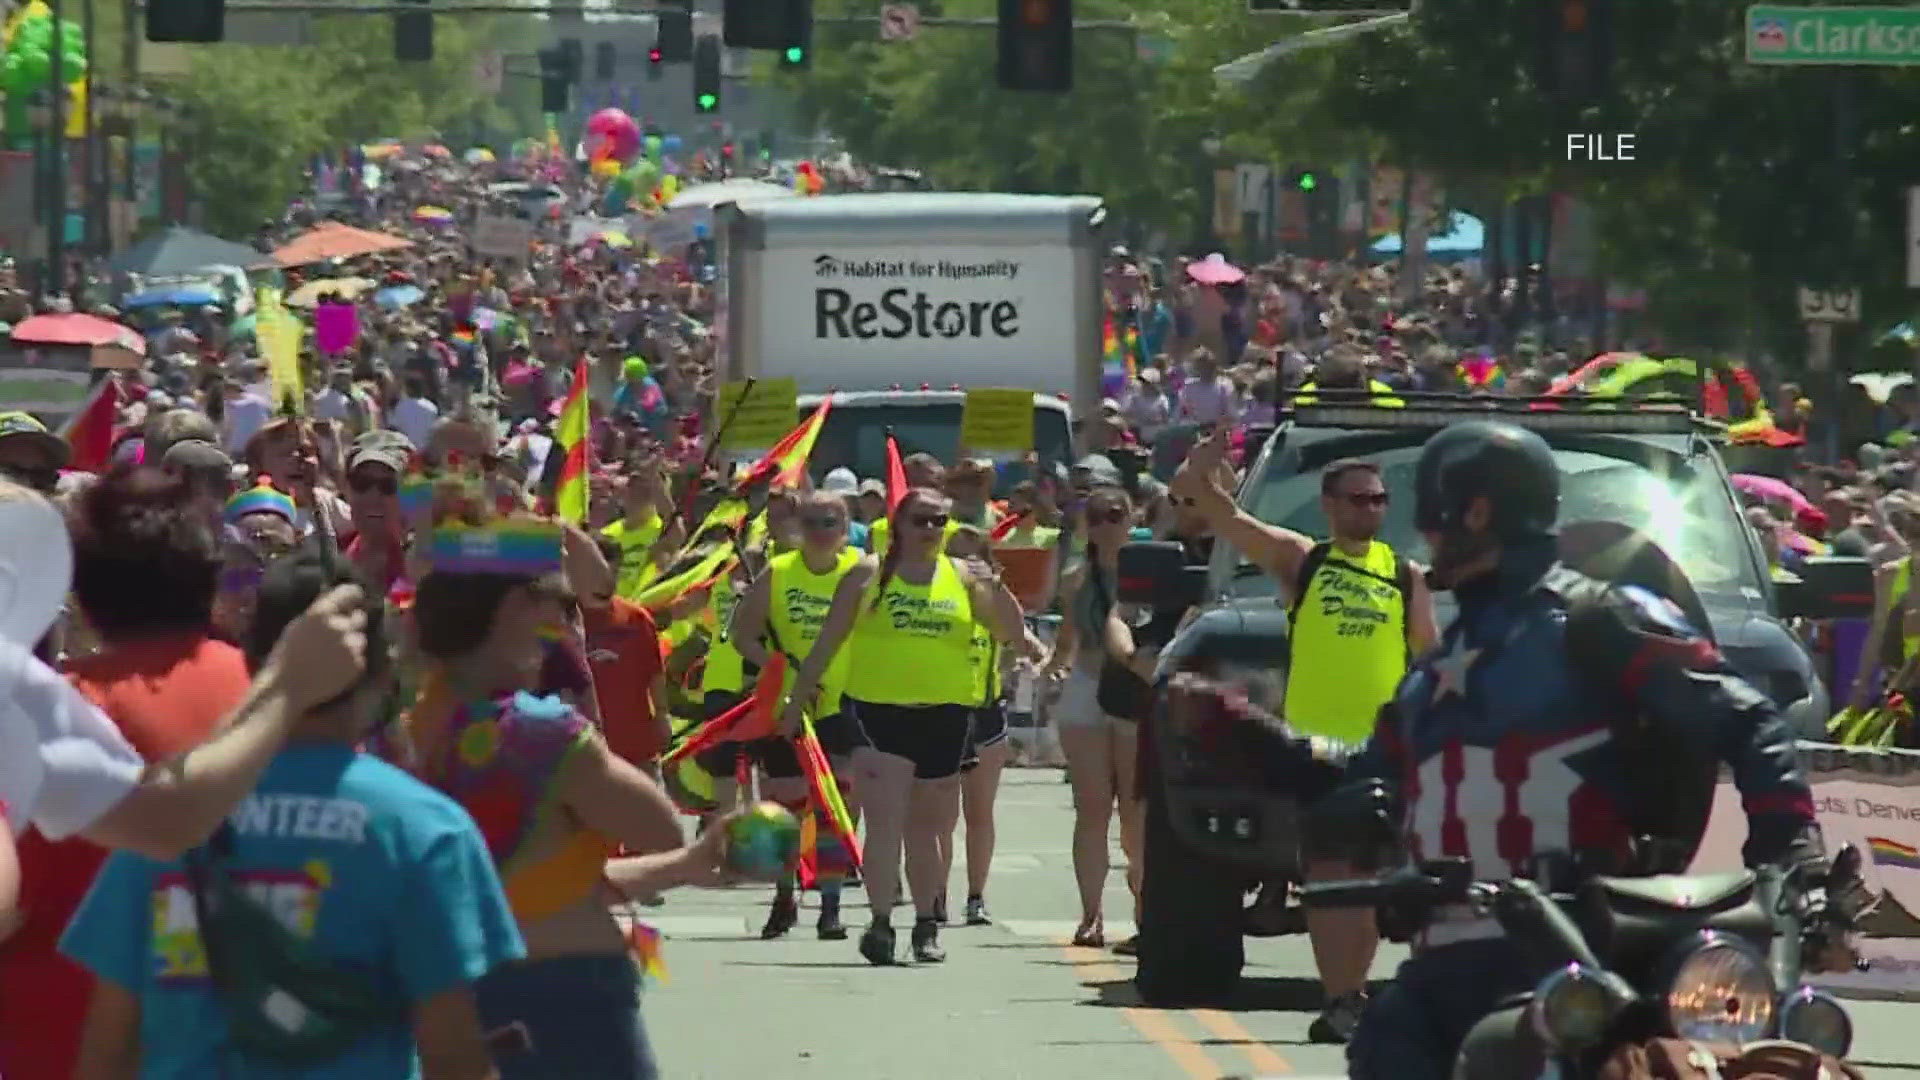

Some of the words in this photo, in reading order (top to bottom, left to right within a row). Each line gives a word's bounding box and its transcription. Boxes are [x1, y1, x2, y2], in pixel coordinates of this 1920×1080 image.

[844, 260, 904, 278] Habitat
[908, 260, 934, 278] for
[938, 259, 1020, 280] Humanity
[815, 287, 1020, 339] ReStore
[237, 793, 367, 843] NTEER
